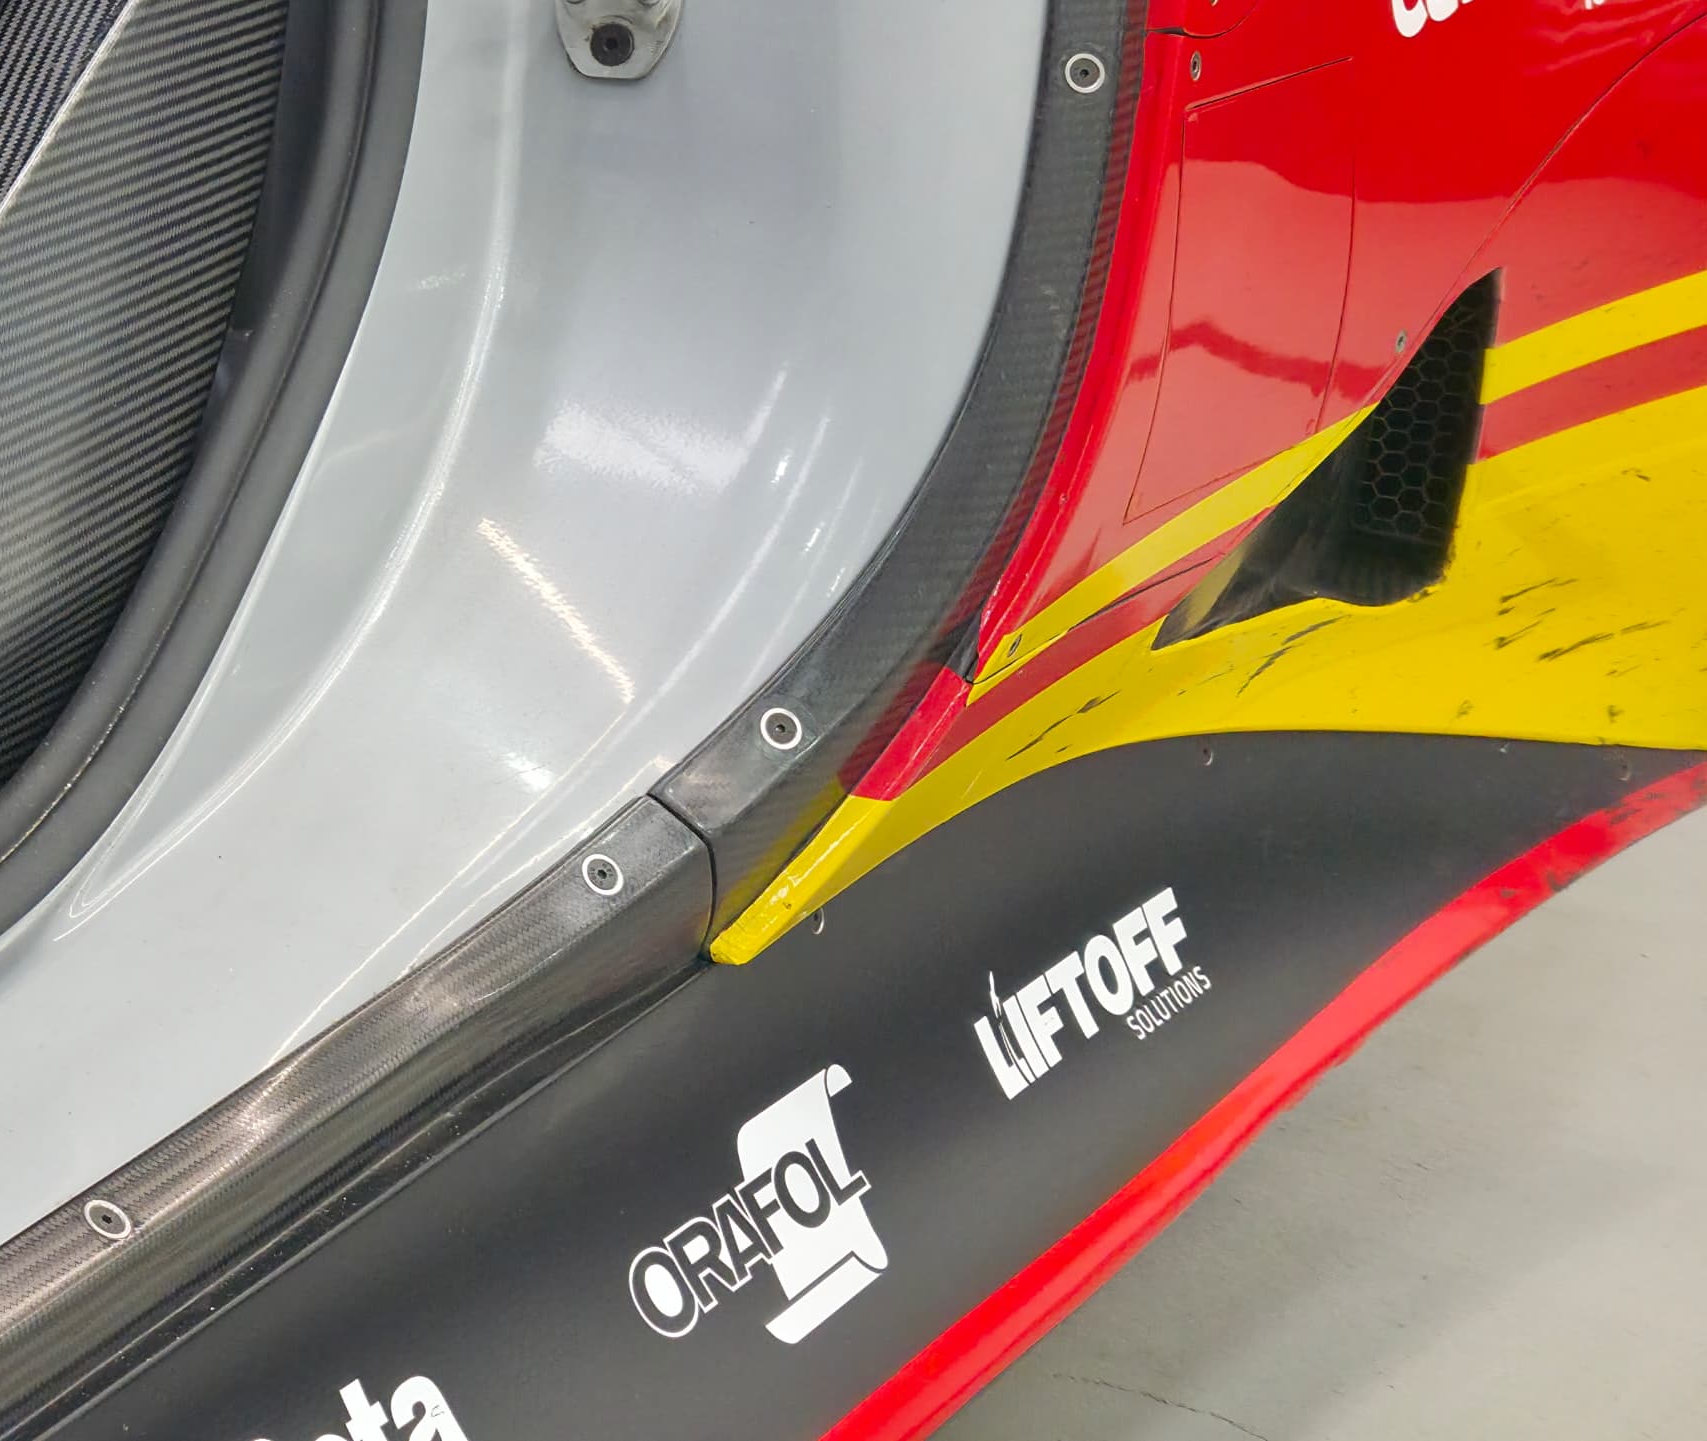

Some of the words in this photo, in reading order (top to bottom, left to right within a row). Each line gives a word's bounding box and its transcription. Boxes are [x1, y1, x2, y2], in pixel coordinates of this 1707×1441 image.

[974, 886, 1188, 1101] LIFTOFF
[1126, 966, 1212, 1041] SOLUTIONS
[628, 1135, 873, 1338] ORAFOL
